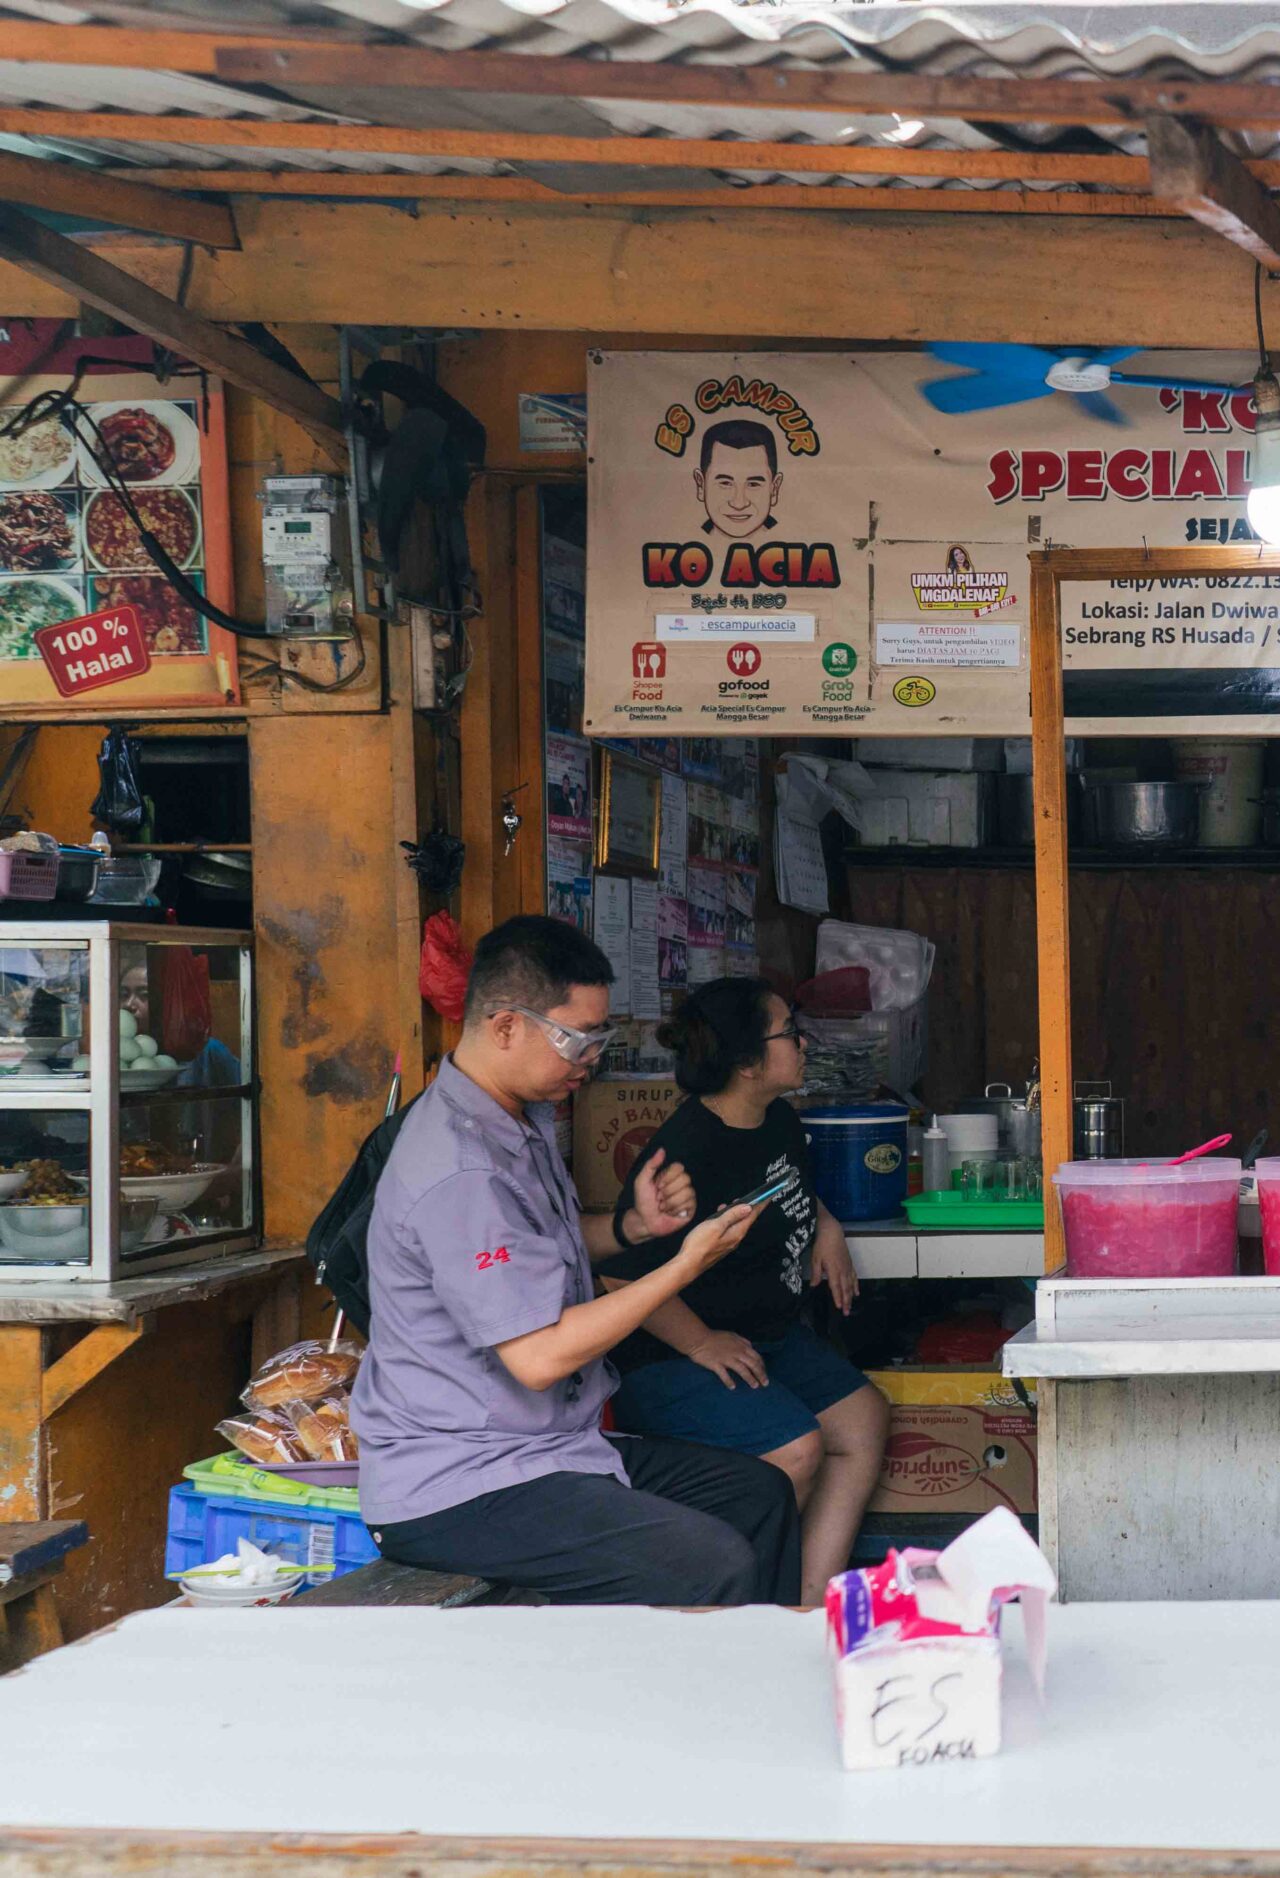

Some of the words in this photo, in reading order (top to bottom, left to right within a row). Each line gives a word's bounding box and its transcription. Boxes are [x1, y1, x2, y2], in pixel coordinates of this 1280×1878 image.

[655, 404, 695, 457] ES
[695, 375, 821, 456] CAMPUR
[986, 449, 1252, 503] SPECIAL
[1185, 518, 1262, 544] SEJA
[644, 543, 712, 587] KO
[722, 543, 840, 587] ACIA
[912, 574, 953, 587] UMKM
[957, 573, 1007, 587] PILIHAN
[920, 588, 999, 602] MGDALENAF
[1081, 601, 1149, 619] Lokasi:
[1154, 601, 1205, 619] Jalan
[707, 620, 796, 632] escampurkoacia
[918, 626, 967, 635] ATTENTION
[52, 626, 98, 656] 100
[102, 617, 128, 640] %
[882, 638, 900, 646] Sorry
[1065, 626, 1145, 647] Sebrang
[1151, 627, 1175, 644] RS
[1182, 627, 1255, 644] Husada
[1261, 625, 1272, 647] /
[66, 645, 133, 683] Halal
[957, 658, 1006, 666] pengertiannya
[633, 681, 662, 690] Shopee
[718, 679, 770, 694] gofood
[821, 679, 854, 692] Grab
[633, 690, 662, 700] Food
[822, 691, 852, 701] Food
[718, 705, 746, 714] Special
[755, 705, 786, 714] Campur
[812, 705, 842, 714] Campur
[716, 713, 747, 722] Mangga
[812, 714, 843, 722] Mangga
[617, 1089, 673, 1101] SIRUP
[597, 1118, 620, 1153] CAP
[625, 1107, 668, 1123] BAN
[475, 1247, 511, 1271] 24
[920, 1416, 968, 1426] Cavendish
[872, 1673, 963, 1747] ES
